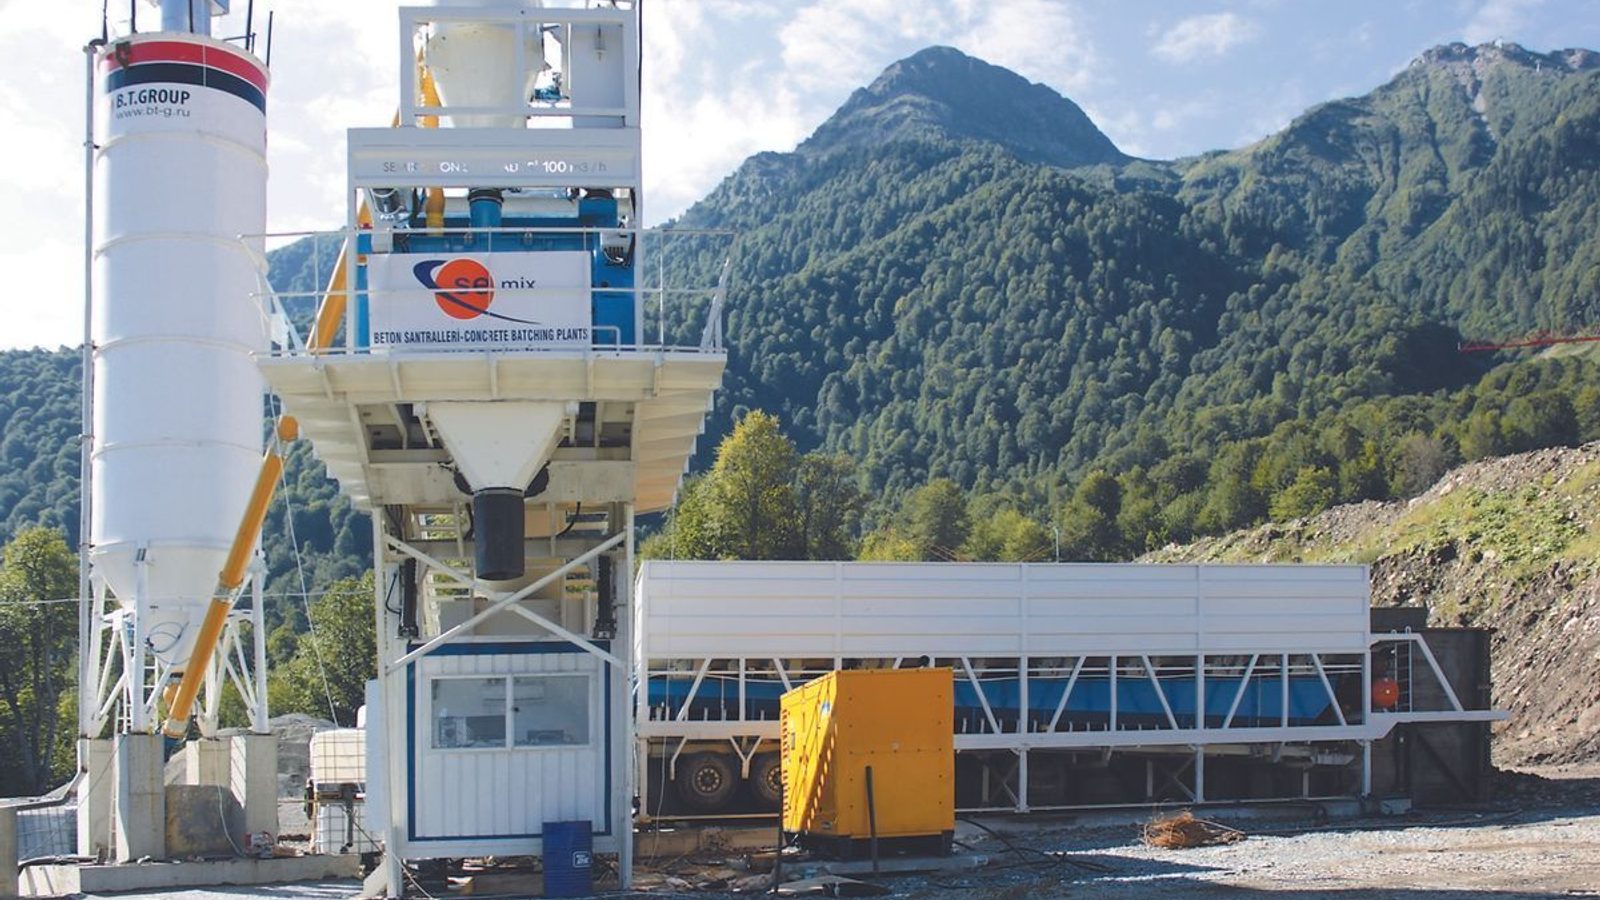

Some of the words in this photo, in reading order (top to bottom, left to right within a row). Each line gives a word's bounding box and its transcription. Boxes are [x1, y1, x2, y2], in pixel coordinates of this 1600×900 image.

[116, 89, 190, 108] B.T.GROUP
[116, 106, 190, 119] www.bt-g.ru
[542, 160, 567, 173] 100
[501, 277, 536, 289] mix
[374, 331, 401, 344] BETON
[511, 328, 554, 341] BATCHING
[556, 327, 588, 340] PLANTS
